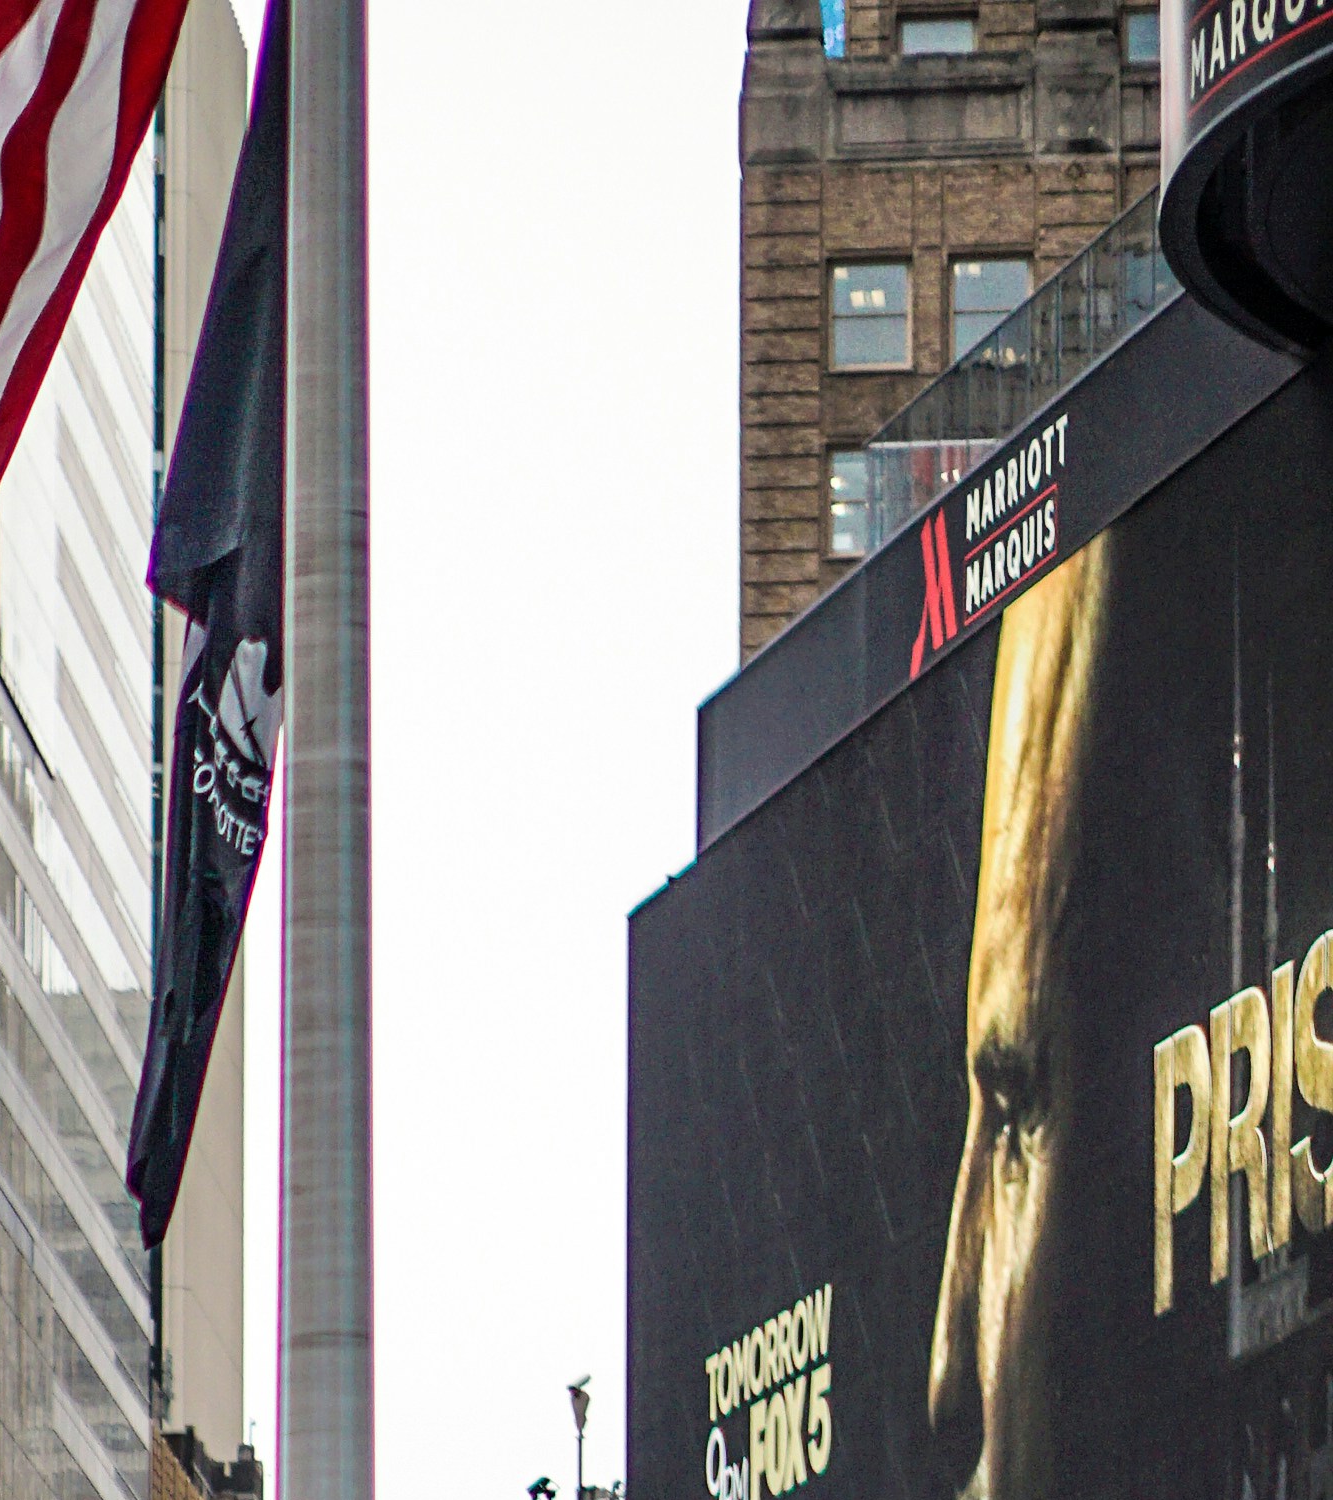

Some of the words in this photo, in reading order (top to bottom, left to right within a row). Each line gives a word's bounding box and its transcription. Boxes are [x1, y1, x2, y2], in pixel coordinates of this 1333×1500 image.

[964, 413, 1069, 541] MARRIOTT
[963, 498, 1056, 615] MARQUIS
[705, 1283, 833, 1423] TOMORROW
[808, 1363, 832, 1475] 5
